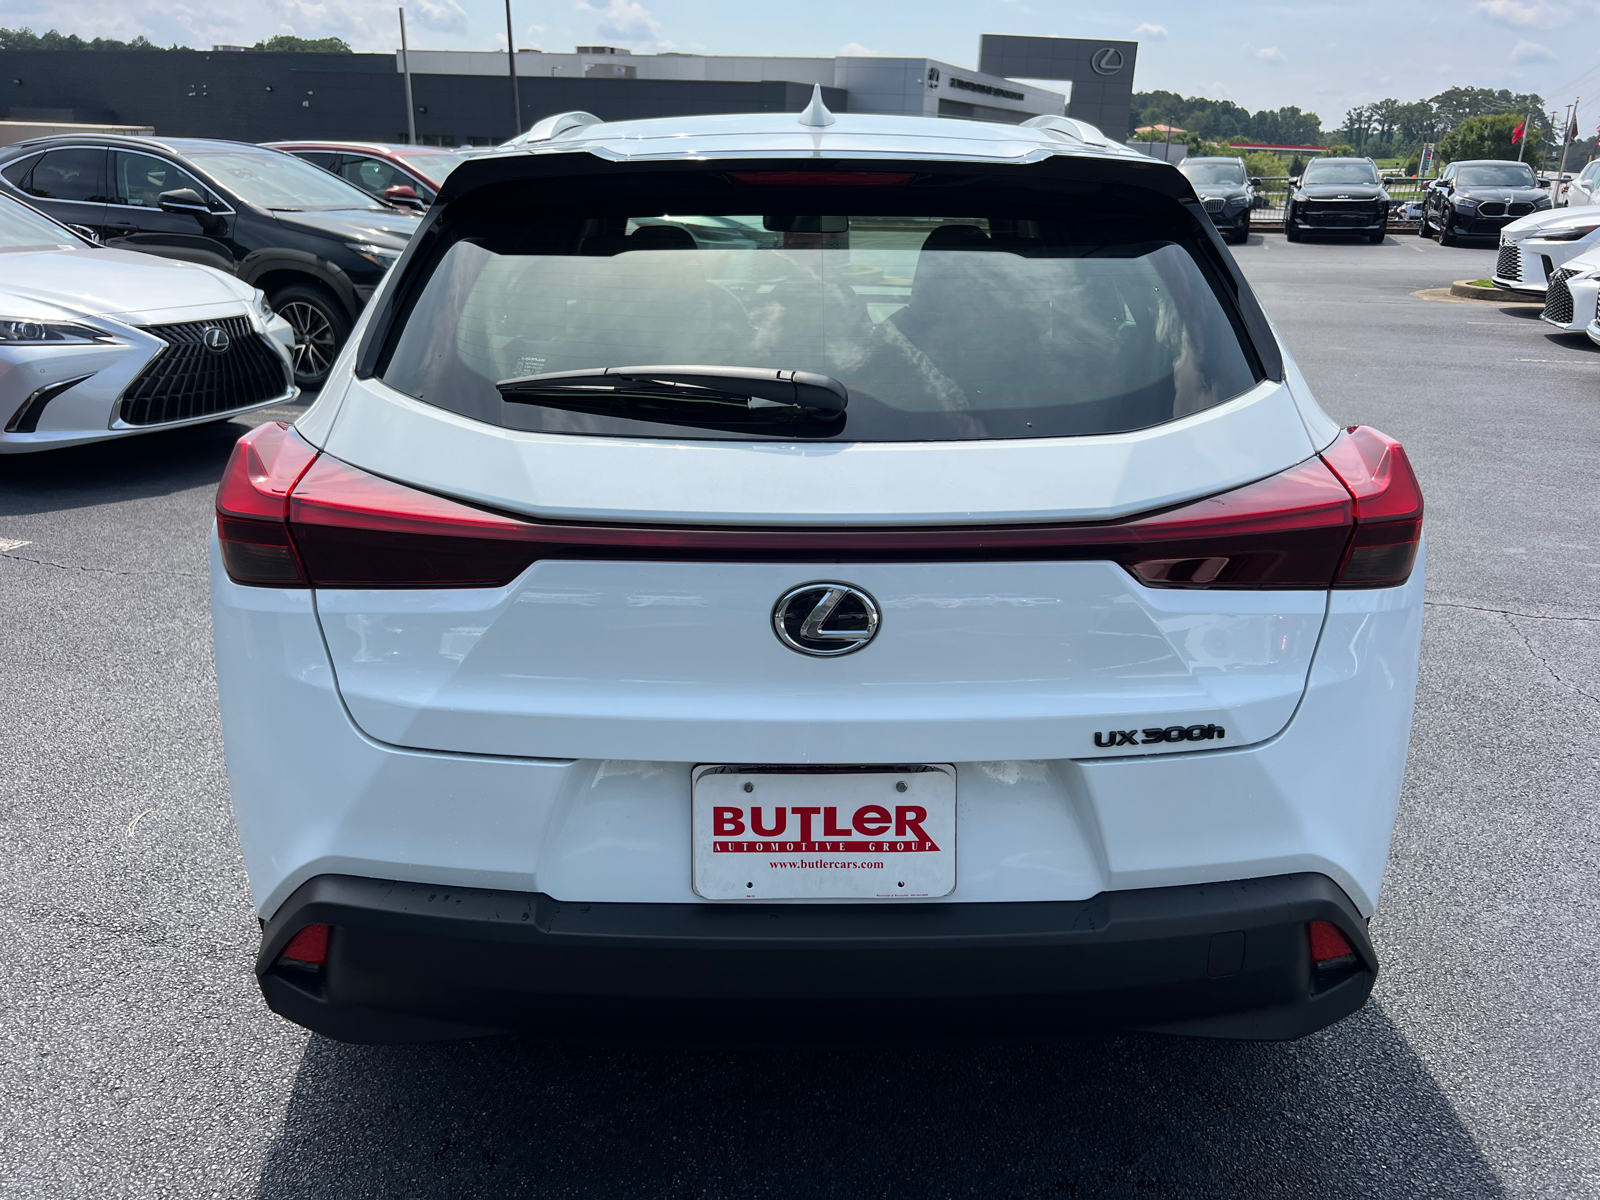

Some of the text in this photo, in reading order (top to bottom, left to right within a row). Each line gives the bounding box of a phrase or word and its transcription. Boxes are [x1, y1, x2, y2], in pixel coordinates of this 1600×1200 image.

[714, 841, 932, 852] AUTOMOTIVE GROUP
[769, 859, 884, 869] www.butlercars.com
